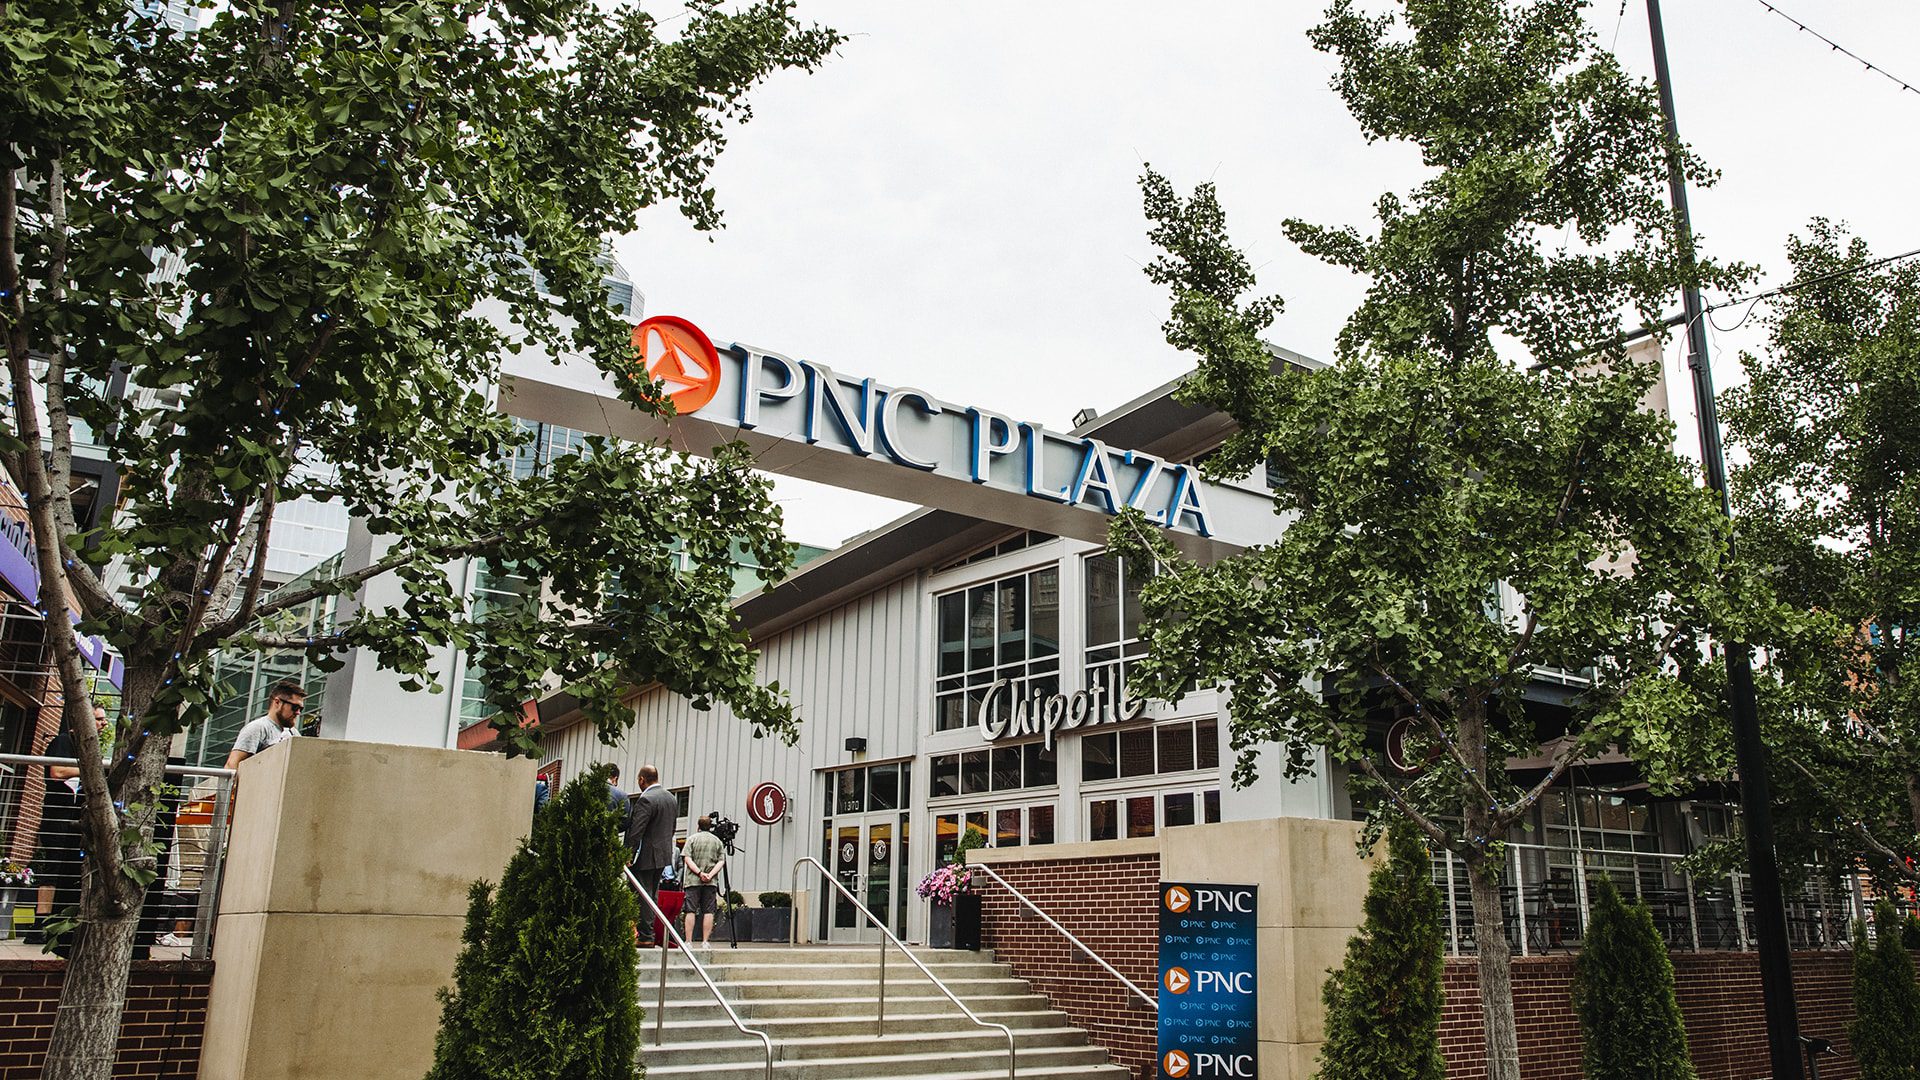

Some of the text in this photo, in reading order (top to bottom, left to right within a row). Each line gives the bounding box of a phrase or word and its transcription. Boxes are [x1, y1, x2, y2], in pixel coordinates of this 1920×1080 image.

[730, 342, 1215, 537] PNC PLAZA
[979, 664, 1148, 751] Chipotle
[1194, 889, 1253, 913] PNC
[1189, 952, 1237, 961] PNC PNC
[1194, 970, 1253, 994] PNC
[1188, 1002, 1237, 1011] PNC PNC
[1173, 1018, 1252, 1028] PNC PNC PNC
[1220, 1036, 1237, 1044] PNC
[1193, 1053, 1253, 1077] PNC
